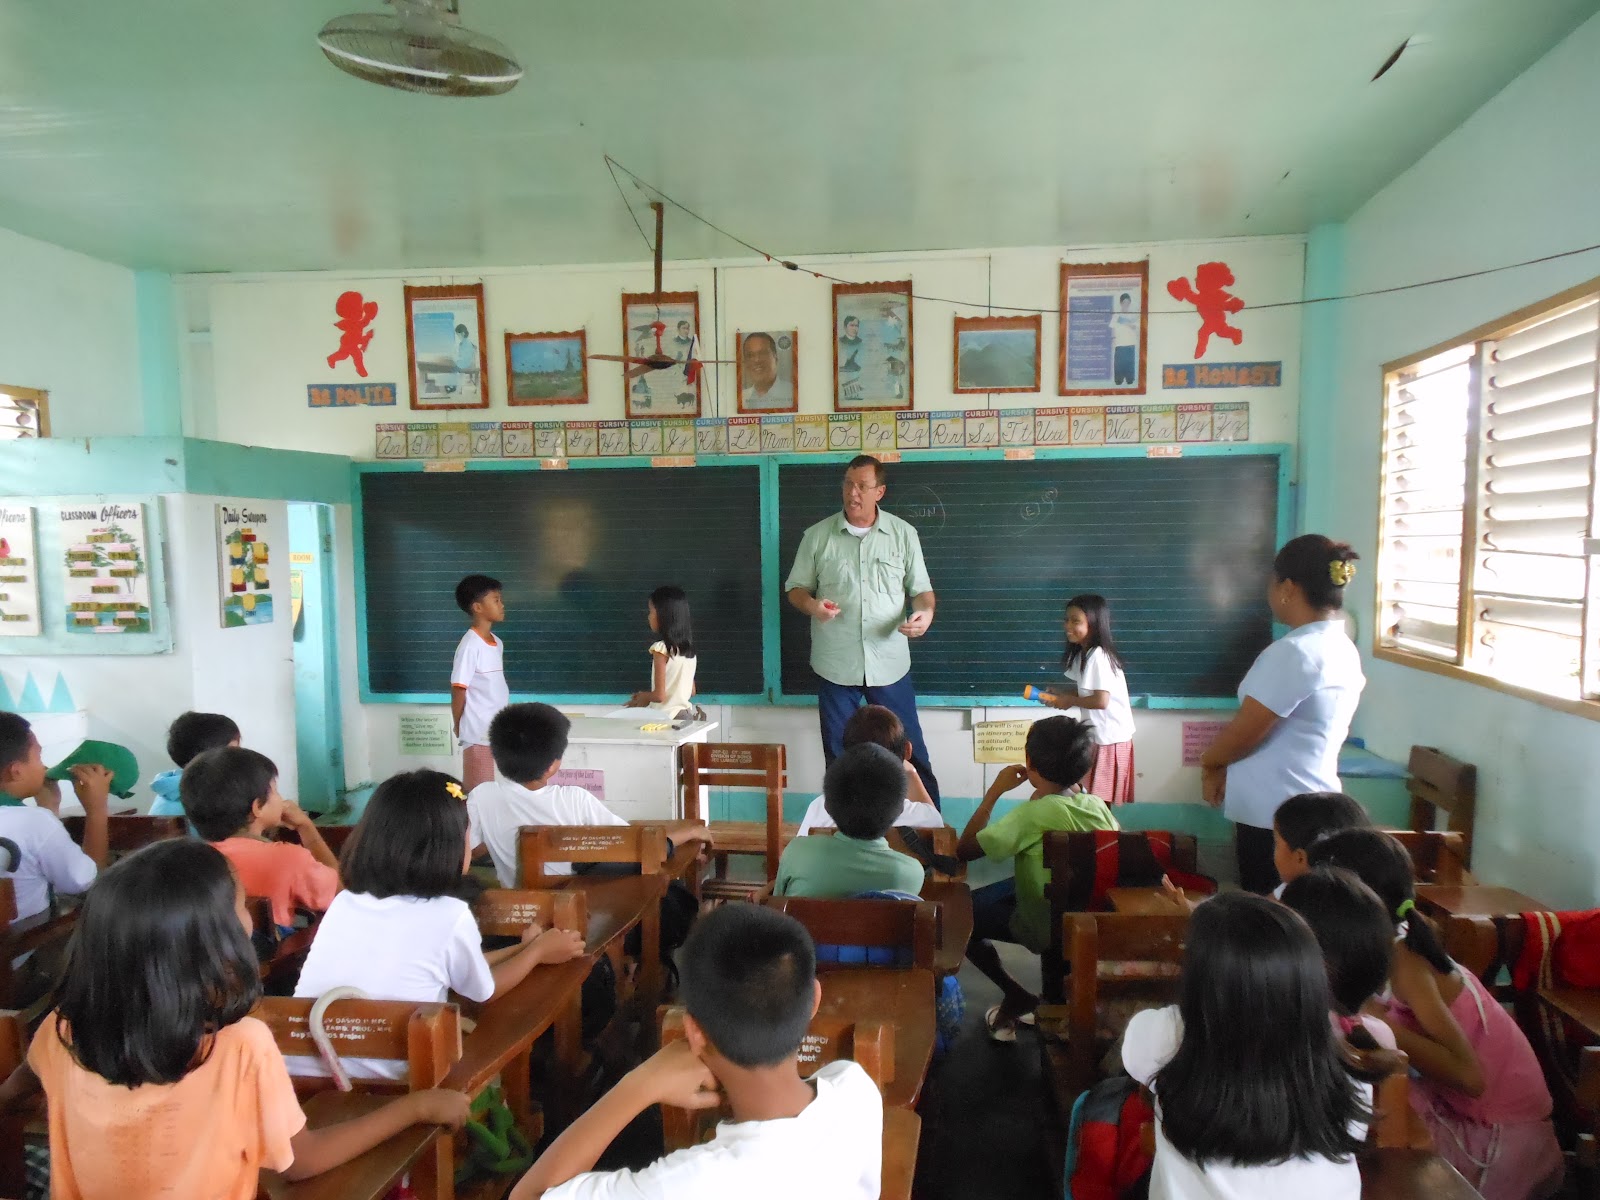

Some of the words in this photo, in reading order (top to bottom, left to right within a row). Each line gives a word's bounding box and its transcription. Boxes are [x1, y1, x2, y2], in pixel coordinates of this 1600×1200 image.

[1070, 406, 1104, 414] CURSIVE
[1177, 403, 1211, 411] CURSIVE
[828, 413, 861, 421] CURSIVE
[61, 511, 97, 521] CLASSROOM
[222, 507, 240, 526] Daily
[801, 1044, 821, 1053] MPC
